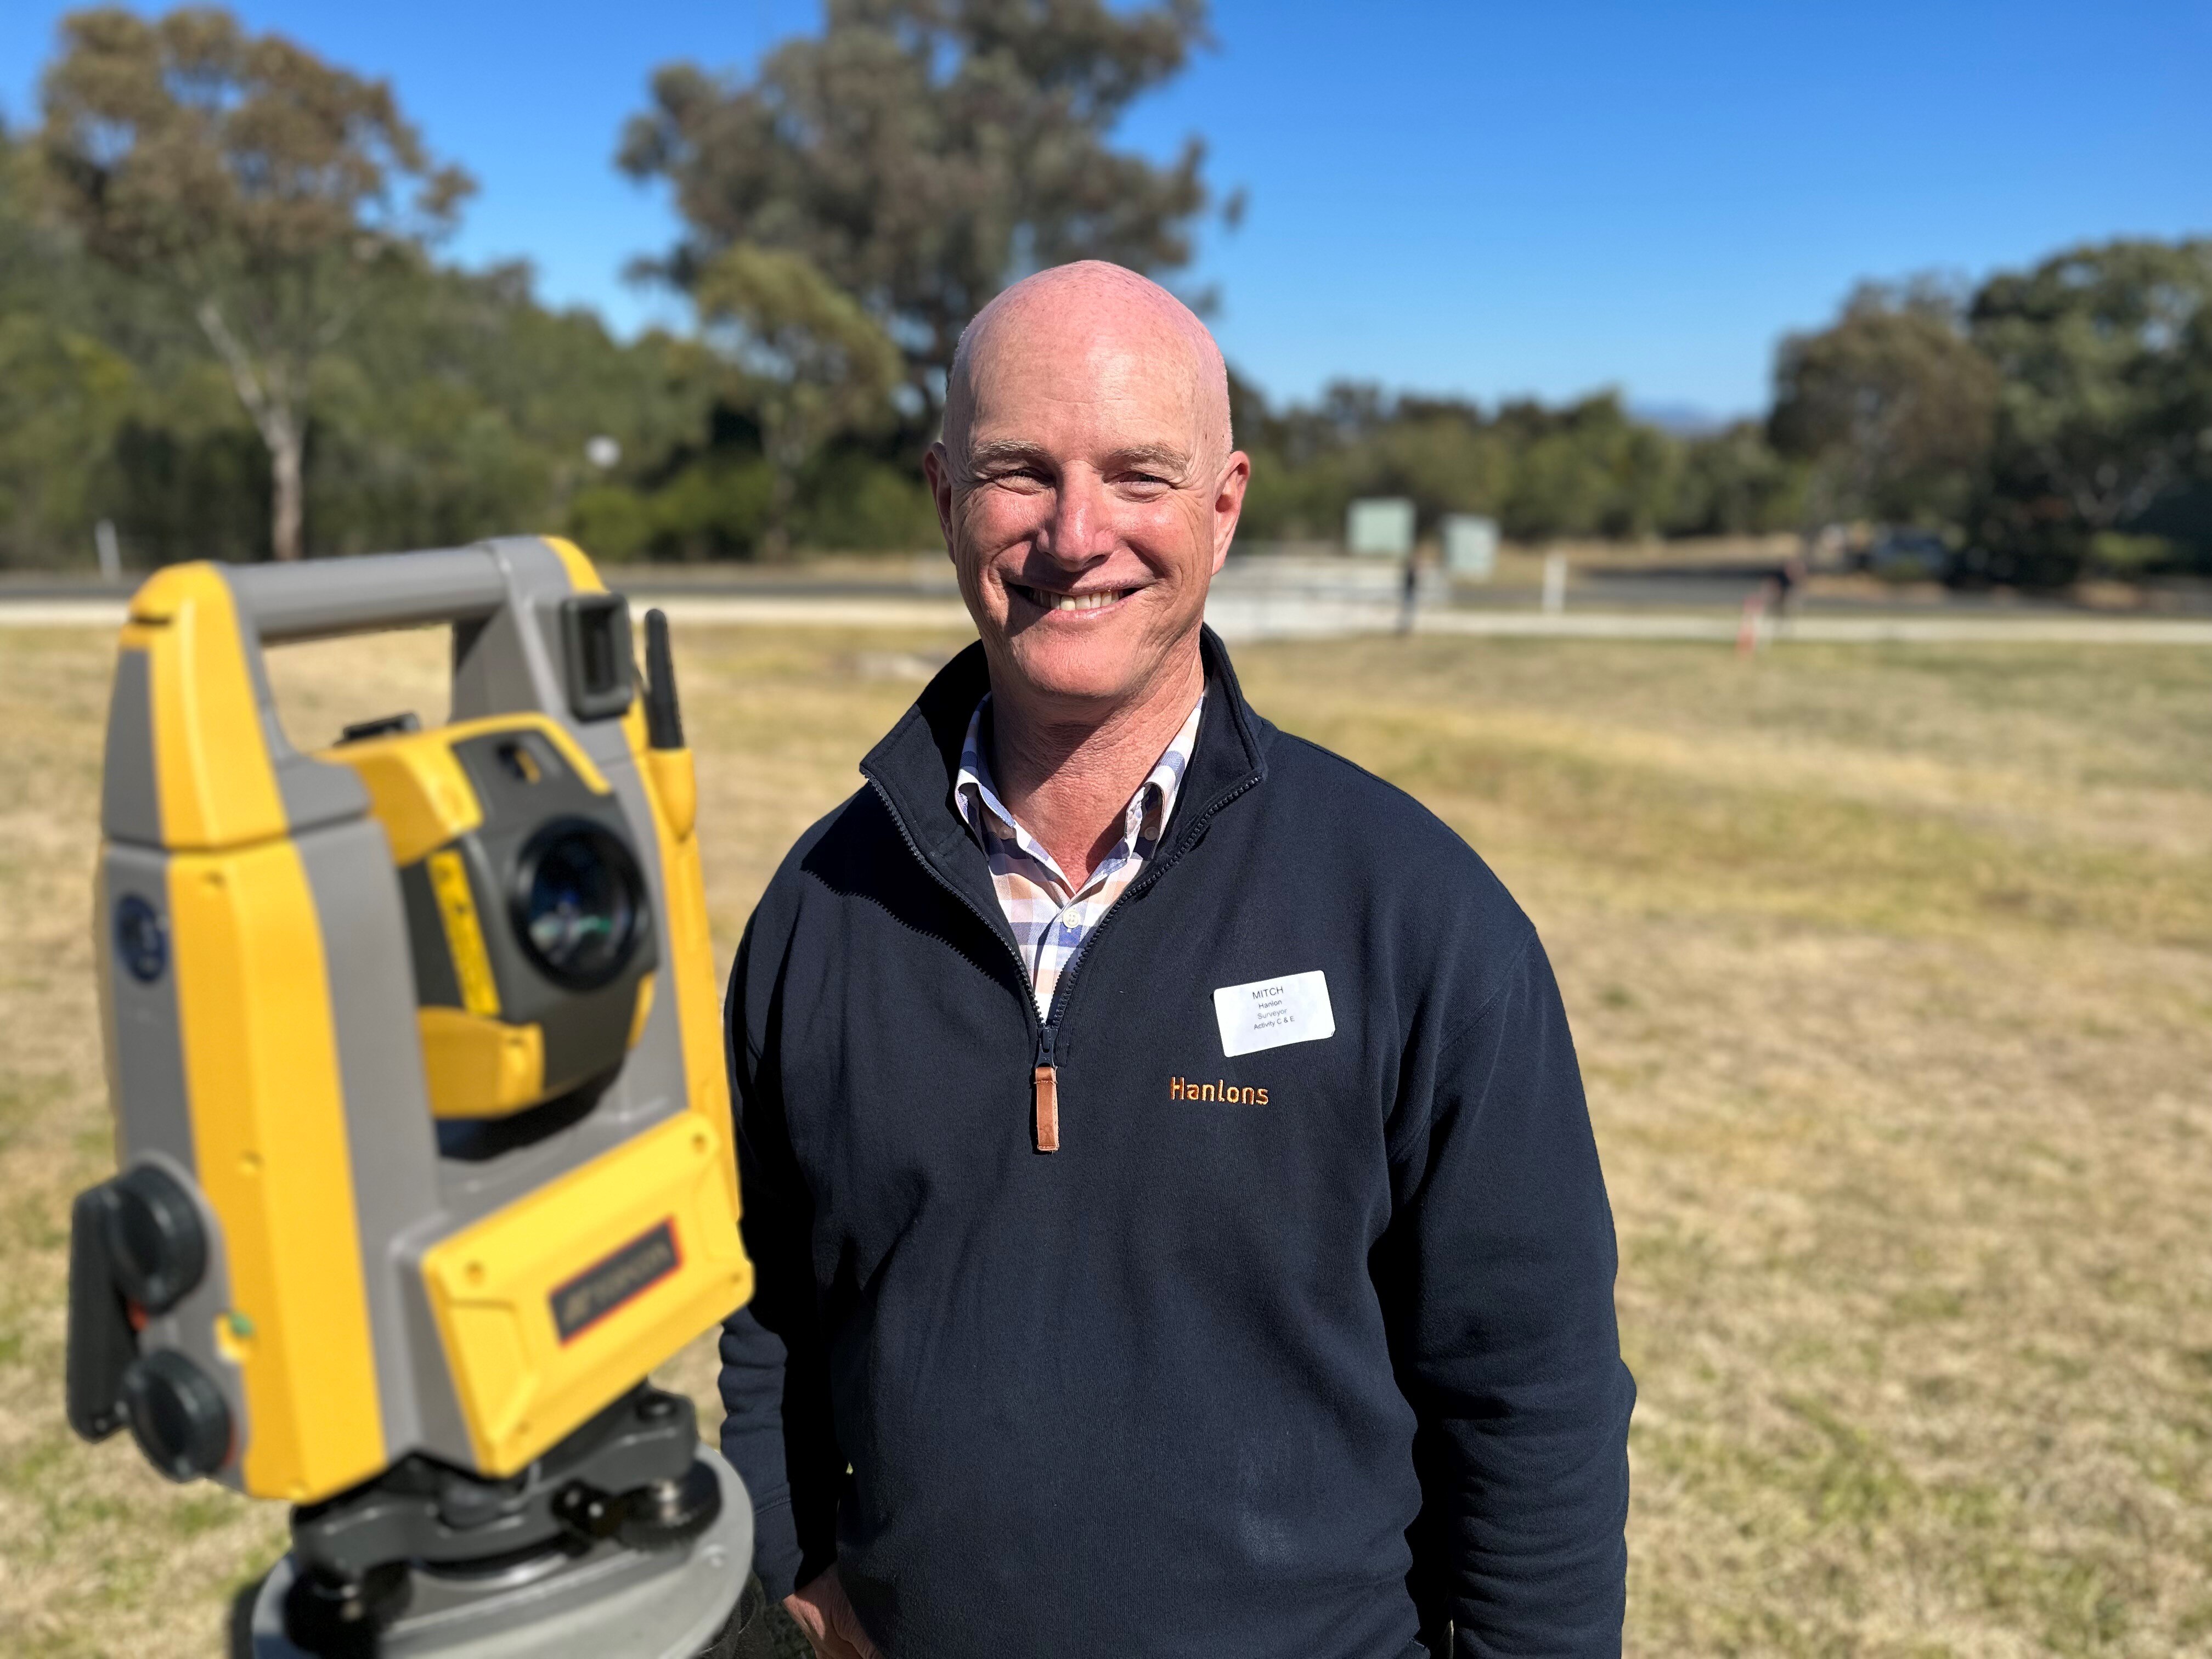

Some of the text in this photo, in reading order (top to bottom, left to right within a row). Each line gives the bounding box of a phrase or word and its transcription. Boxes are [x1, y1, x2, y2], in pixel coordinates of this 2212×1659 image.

[1252, 986, 1284, 999] MITCH
[1259, 1000, 1282, 1009] Hanlon
[1257, 1008, 1287, 1019] Surveyor
[1254, 1020, 1275, 1030] Activity
[1170, 1076, 1269, 1105] Hanlons
